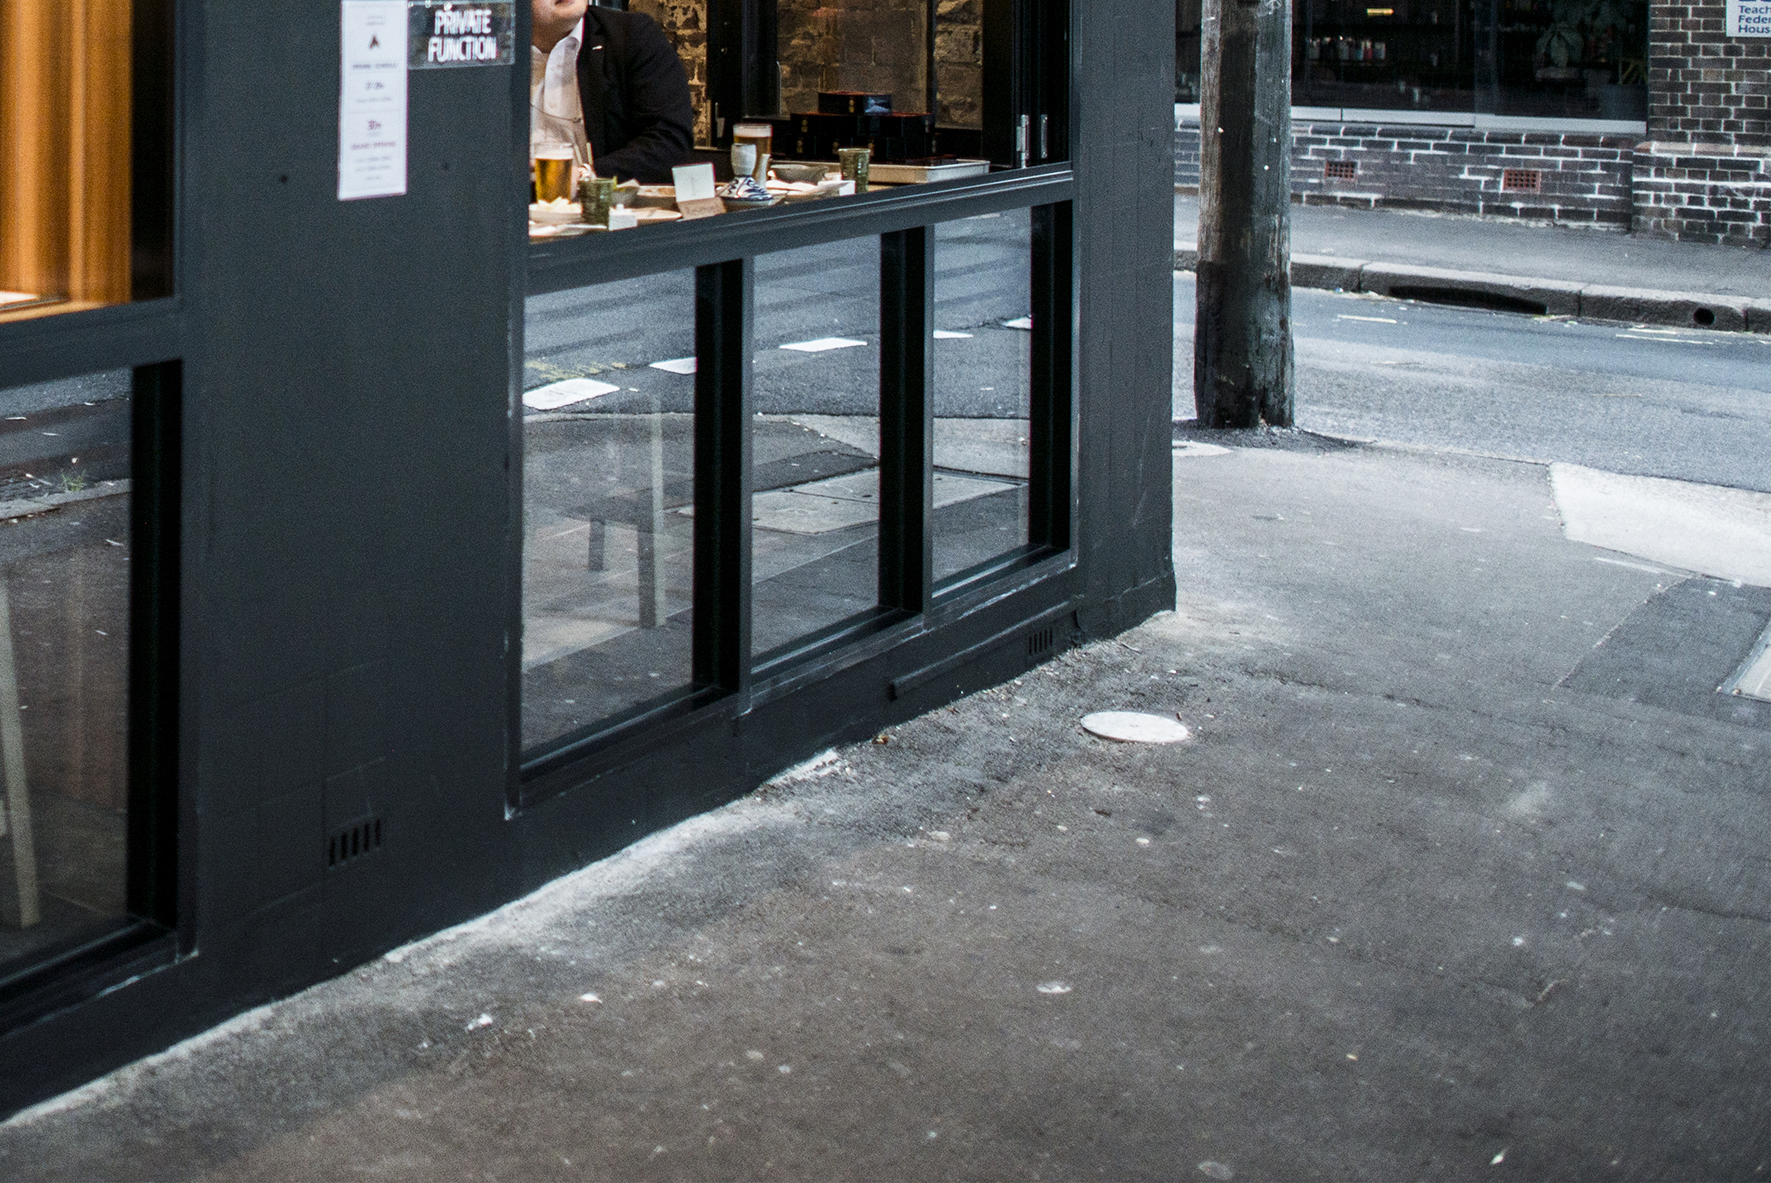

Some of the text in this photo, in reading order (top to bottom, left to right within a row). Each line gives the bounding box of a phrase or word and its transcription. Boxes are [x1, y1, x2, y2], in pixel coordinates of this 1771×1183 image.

[434, 9, 492, 35] PRIVATE
[1738, 25, 1770, 34] Hous
[428, 36, 497, 62] FUNCTION
